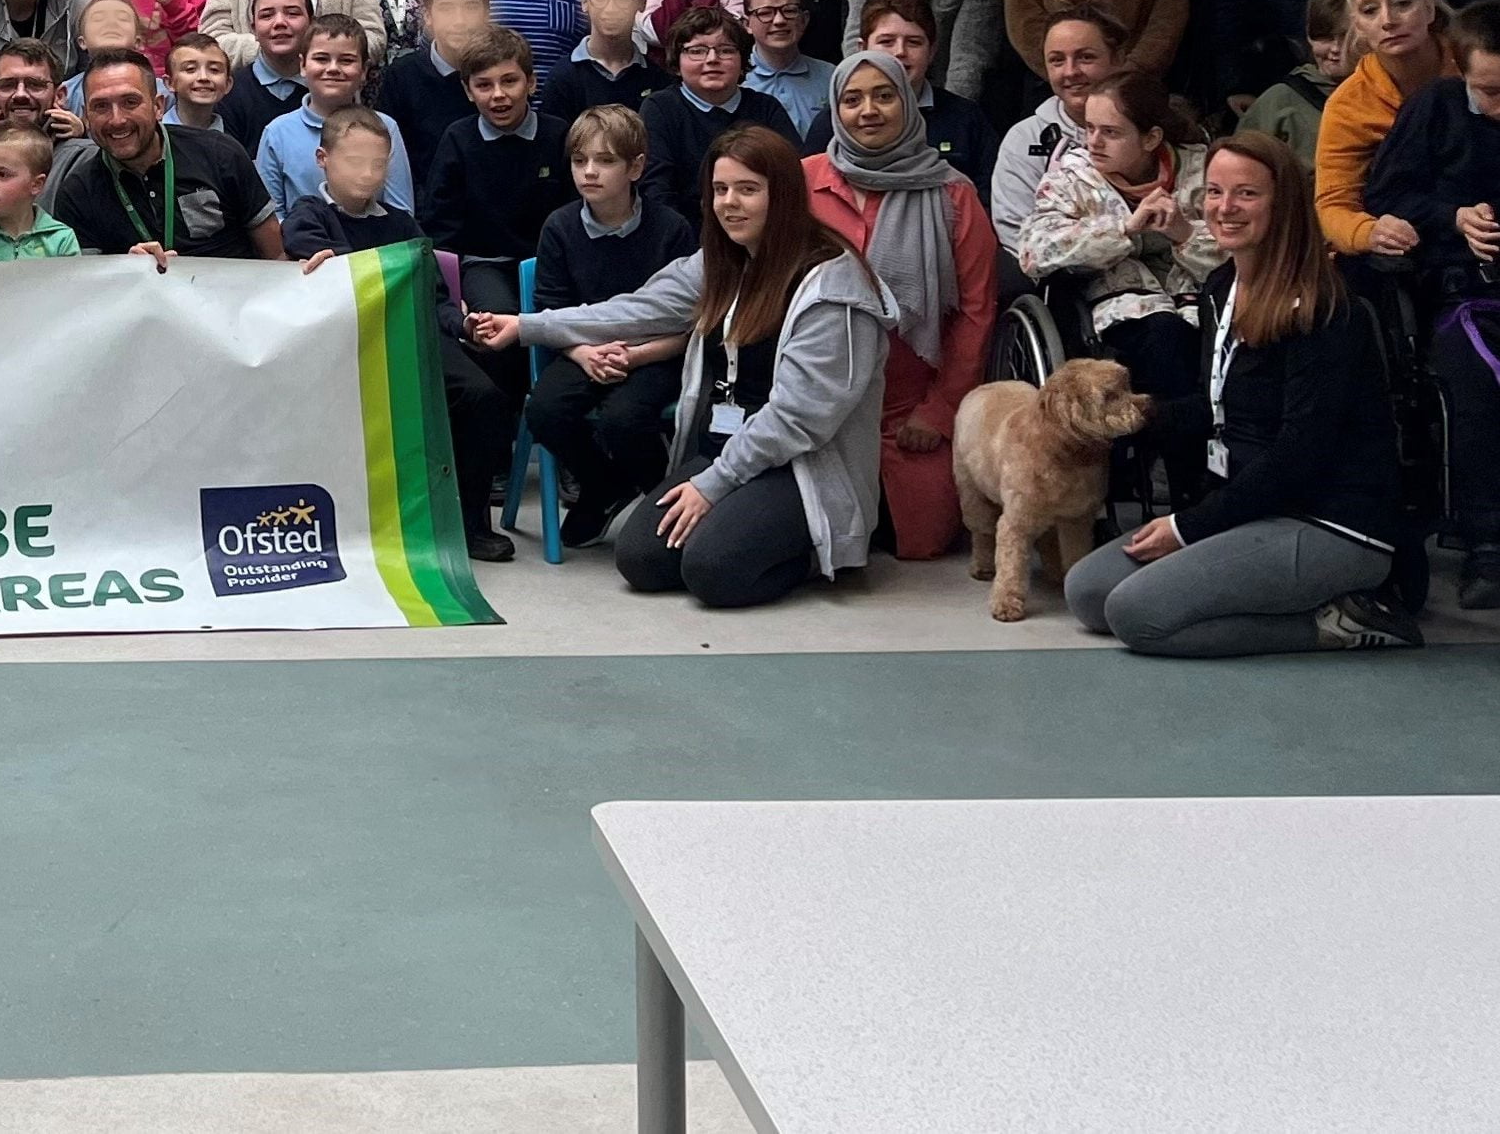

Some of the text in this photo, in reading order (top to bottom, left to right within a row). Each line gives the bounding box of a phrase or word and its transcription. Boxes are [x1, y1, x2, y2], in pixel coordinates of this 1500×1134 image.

[218, 520, 322, 555] Ofsted
[223, 559, 328, 576] Outstanding
[228, 572, 298, 587] Provider
